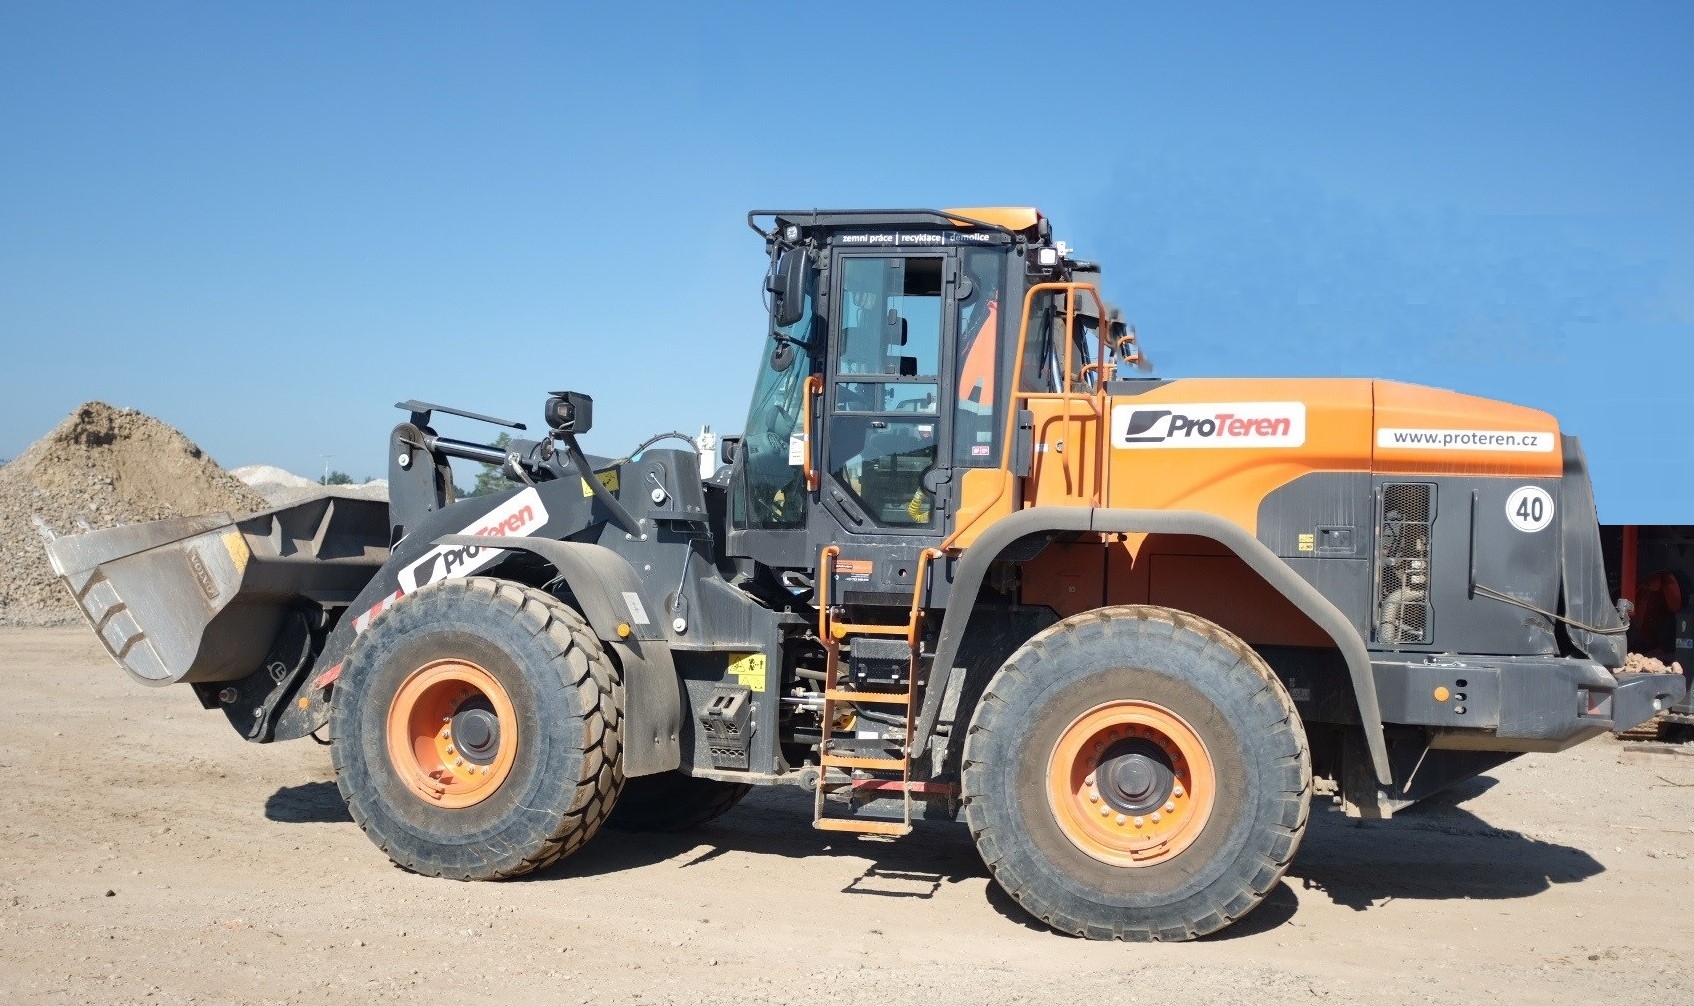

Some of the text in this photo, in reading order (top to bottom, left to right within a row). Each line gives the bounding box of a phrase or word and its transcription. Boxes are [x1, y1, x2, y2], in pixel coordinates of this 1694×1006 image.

[869, 233, 893, 244] práce
[901, 233, 941, 244] recyklace
[1166, 413, 1291, 438] ProTeren
[1393, 432, 1539, 447] www.proteren.cz
[1515, 496, 1544, 523] 40
[190, 554, 214, 593] VOLVO
